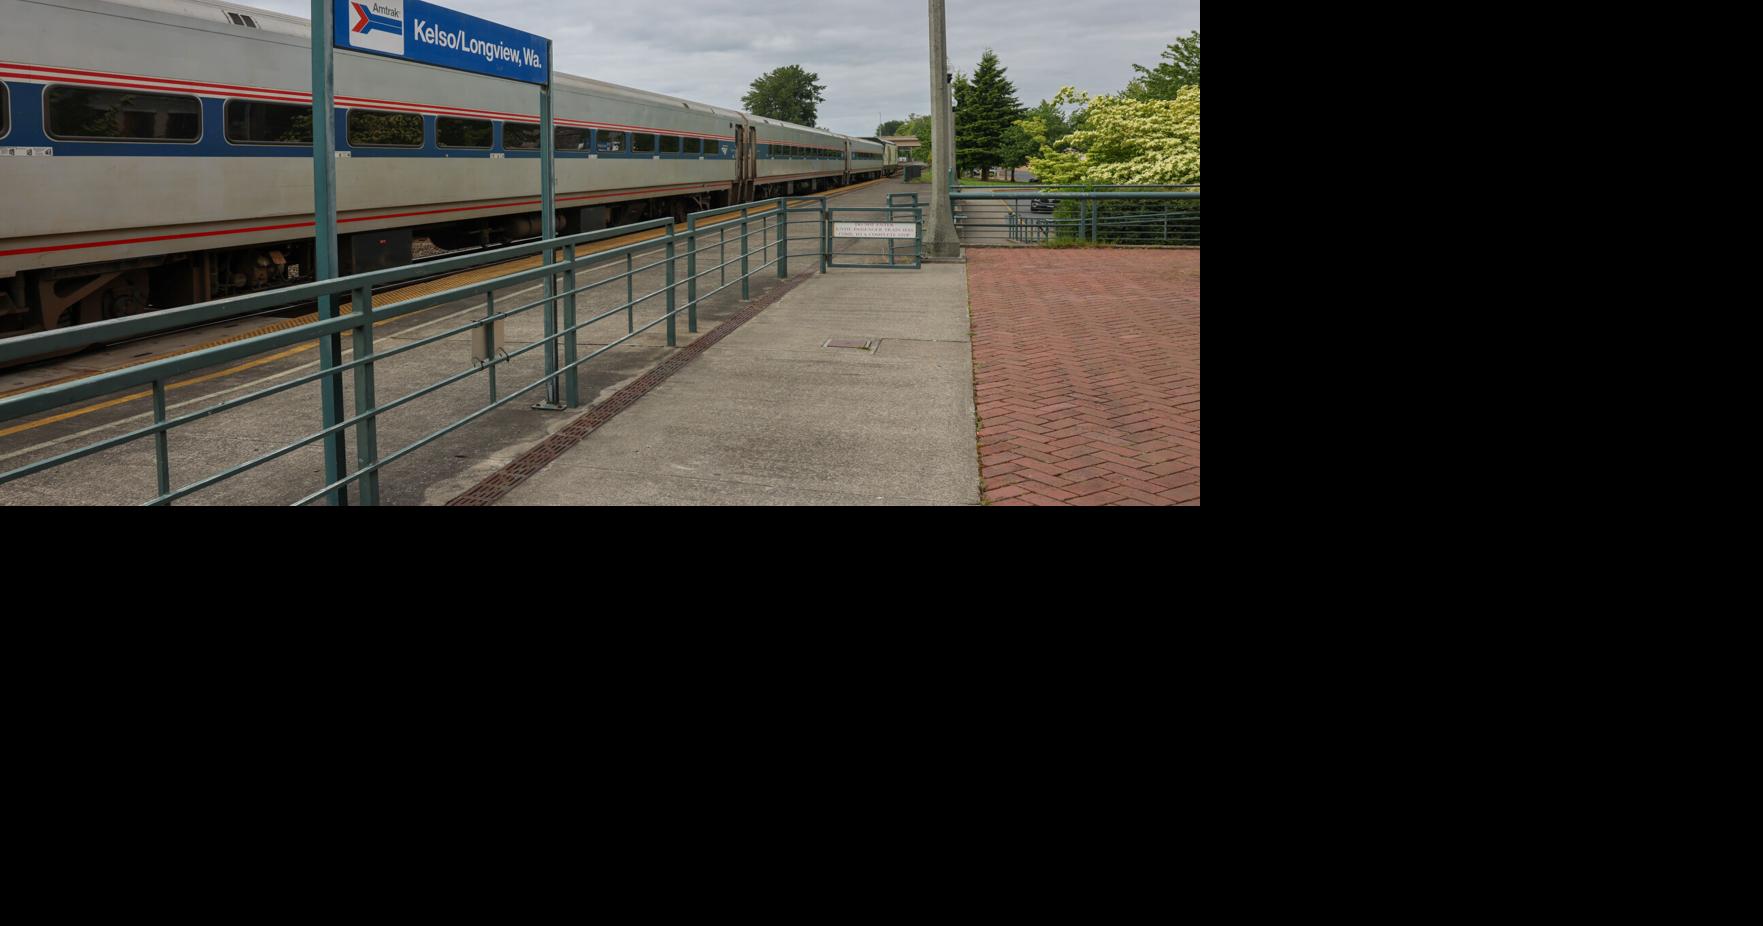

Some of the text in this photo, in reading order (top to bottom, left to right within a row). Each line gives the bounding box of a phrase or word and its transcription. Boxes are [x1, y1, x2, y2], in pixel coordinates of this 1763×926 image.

[373, 3, 399, 18] Amtrak
[414, 19, 542, 68] Kelso/Longview, Wa.
